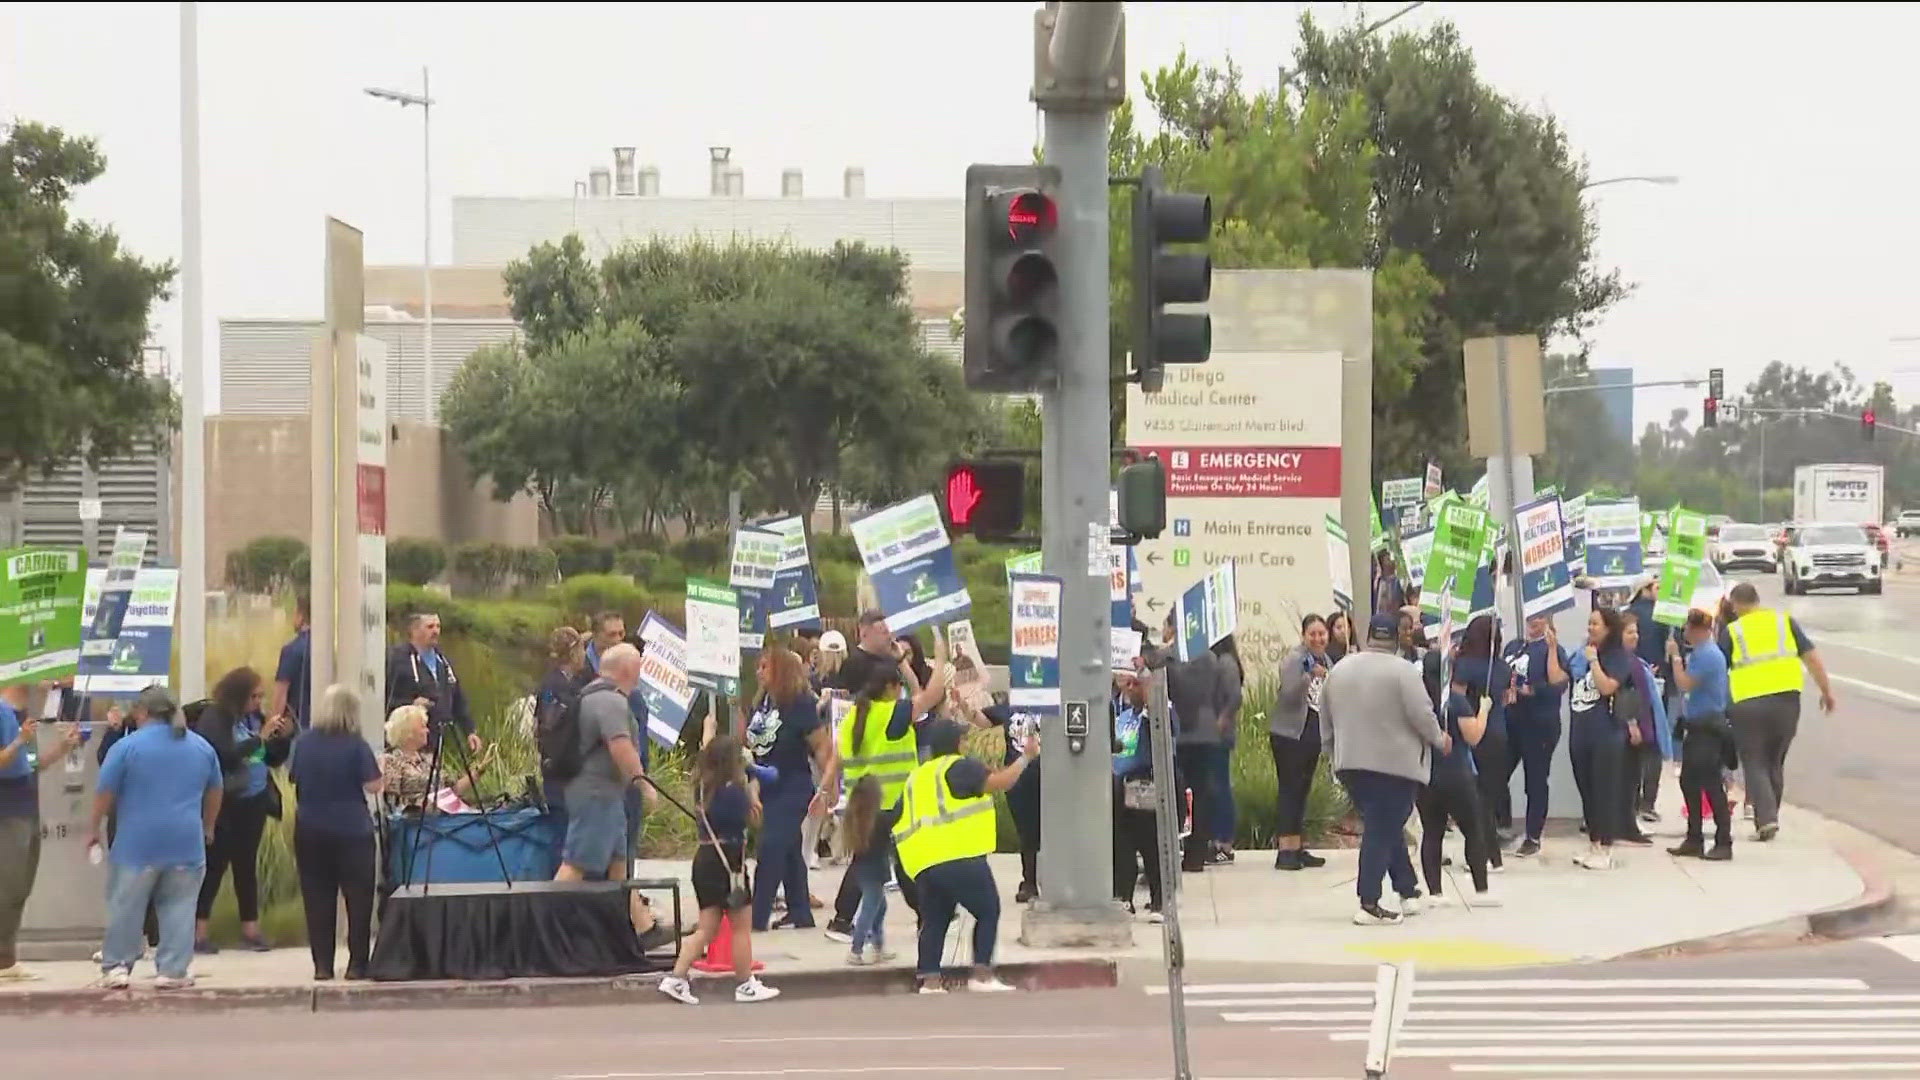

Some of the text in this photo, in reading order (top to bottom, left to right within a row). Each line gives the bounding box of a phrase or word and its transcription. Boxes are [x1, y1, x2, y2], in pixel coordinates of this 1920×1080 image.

[1180, 367, 1224, 387] Diego
[1145, 389, 1257, 406] Medical Center
[1200, 452, 1302, 469] EMERGENCY
[1170, 473, 1302, 484] Basic Emergency Medical Service
[1170, 483, 1283, 494] Physician On Duty 24 Hours
[1204, 520, 1242, 536] Main
[1247, 520, 1312, 536] Entrance
[15, 554, 69, 575] CARING
[1259, 551, 1296, 567] Care
[1014, 625, 1057, 648] WORKERS
